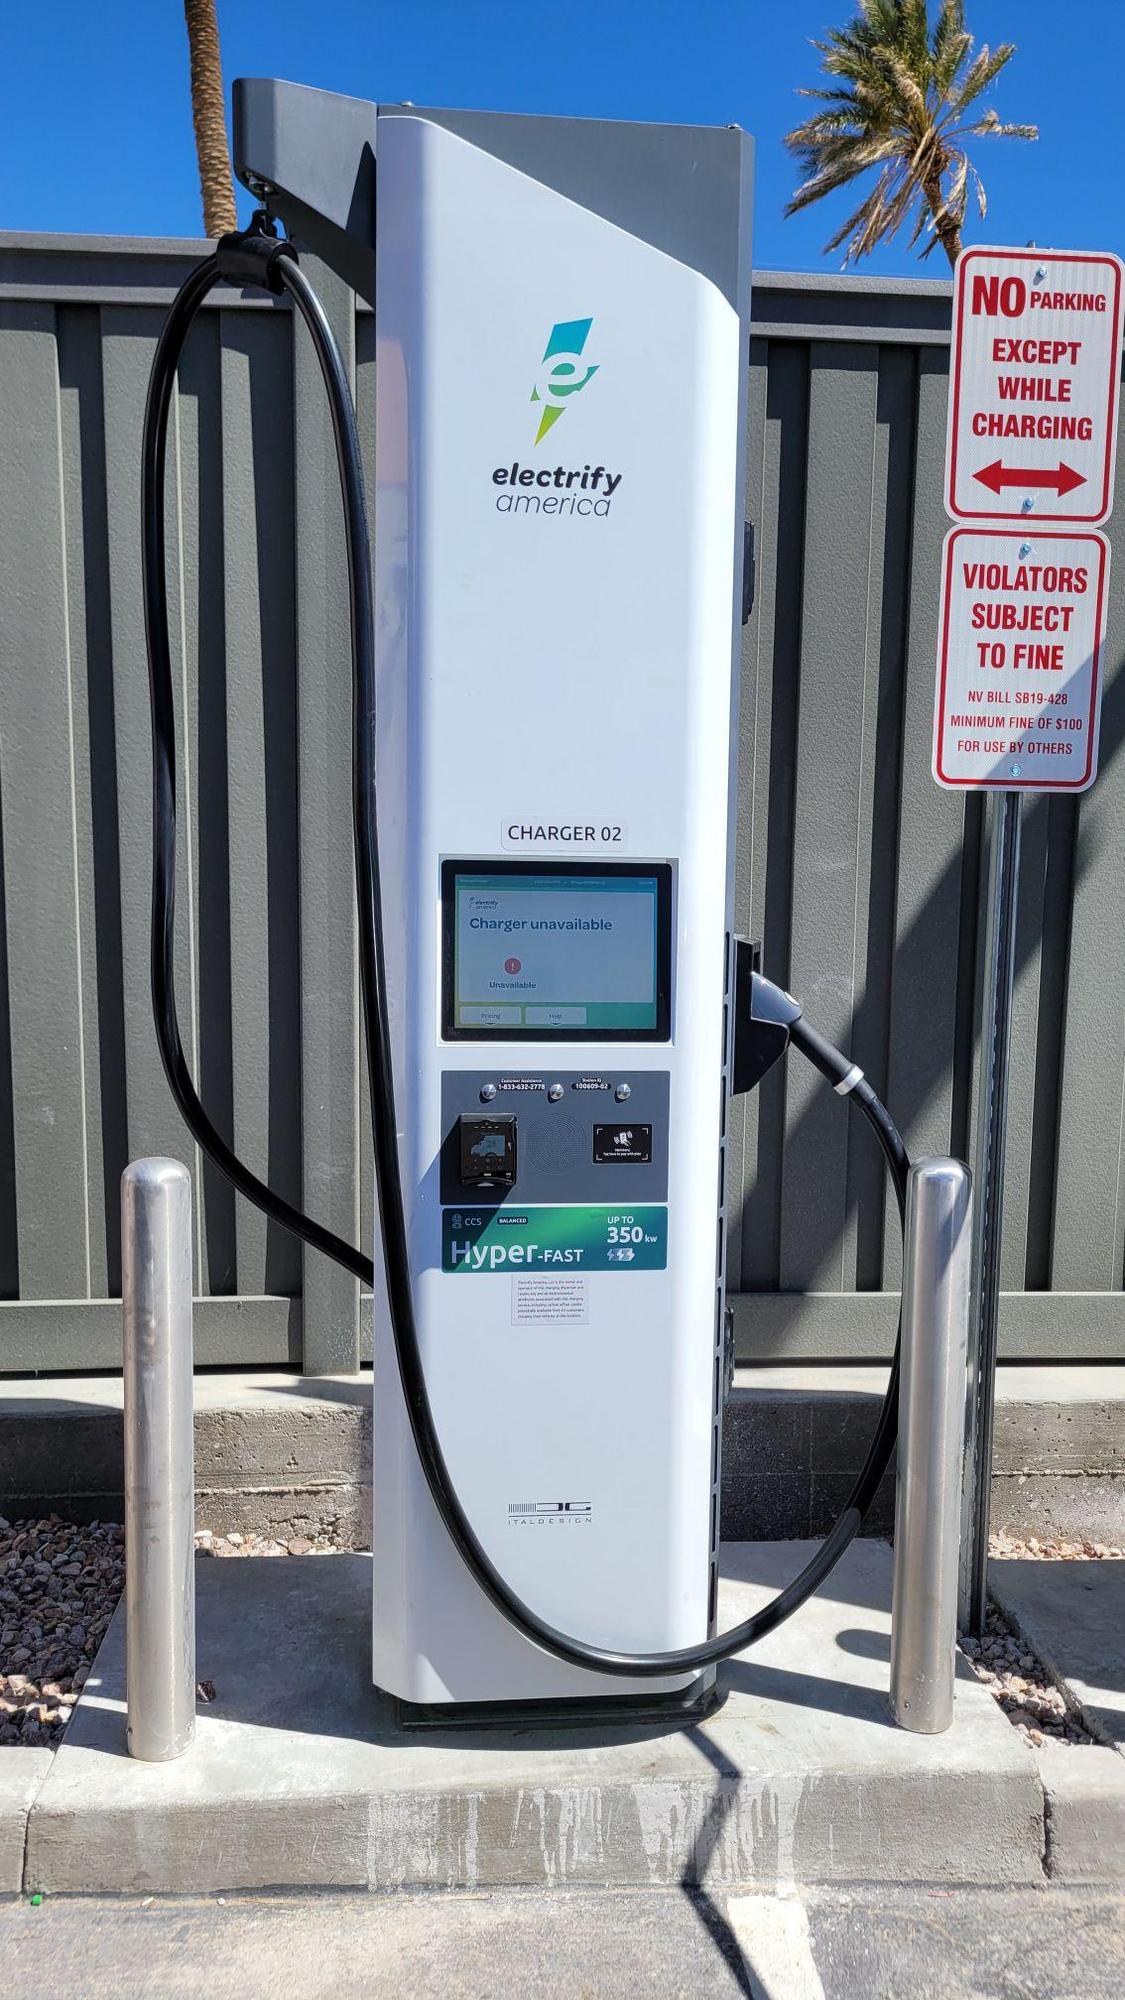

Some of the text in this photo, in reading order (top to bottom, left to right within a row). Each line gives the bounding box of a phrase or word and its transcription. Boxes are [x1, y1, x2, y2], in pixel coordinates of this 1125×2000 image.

[972, 276, 1106, 317] NO PARKING
[992, 338, 1081, 365] EXCEPT
[998, 376, 1072, 402] WHILE
[972, 412, 1092, 440] CHARGING
[492, 462, 622, 496] electrify
[496, 493, 611, 517] america
[963, 563, 1088, 594] VIOLATORS
[971, 602, 1074, 632] SUBJECT
[977, 642, 1064, 670] TO FINE
[968, 690, 1068, 705] NV BILL SB19-428
[951, 714, 1082, 730] MINIMUM FINE OF $100
[957, 740, 1073, 755] FOR USE BY OTHERS
[508, 825, 622, 841] CHARGER 02
[469, 917, 613, 932] Charger unavailable
[489, 981, 537, 989] Unavailable
[464, 1217, 482, 1226] CCS
[607, 1216, 634, 1224] UP TO
[607, 1226, 644, 1243] 350
